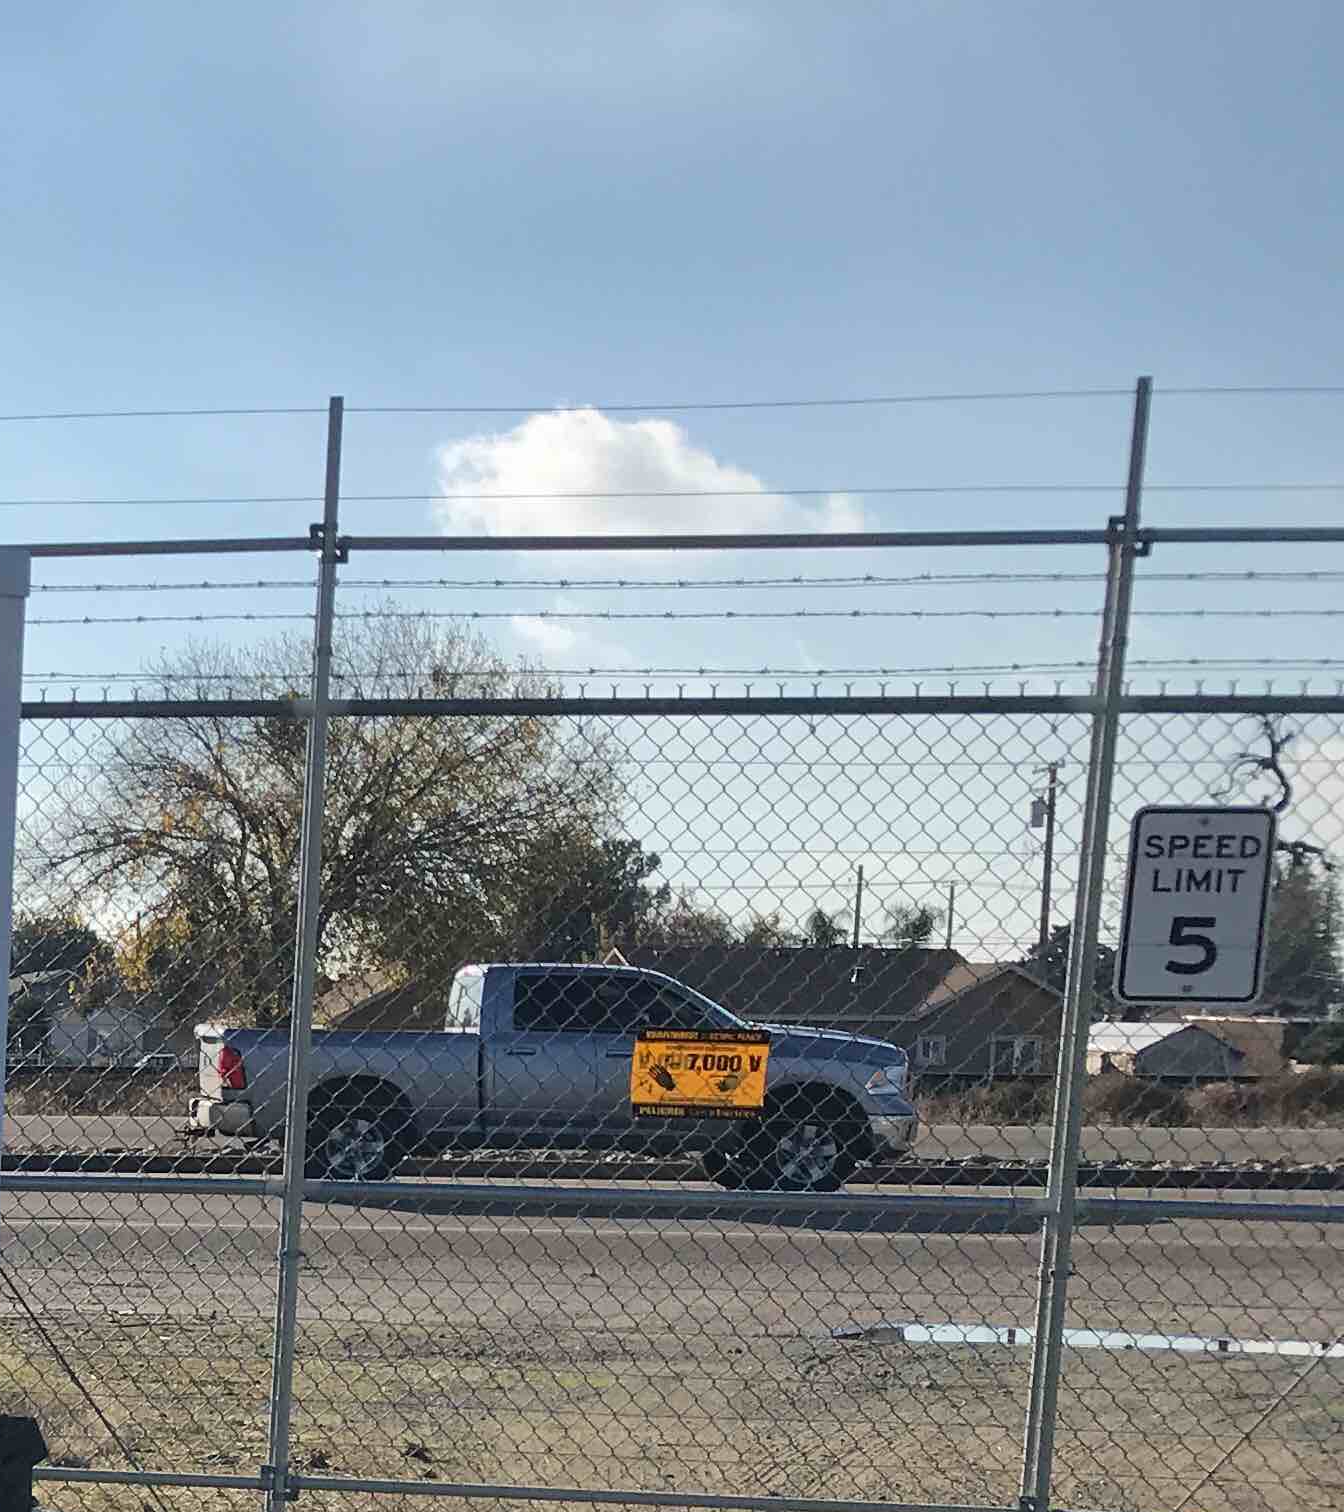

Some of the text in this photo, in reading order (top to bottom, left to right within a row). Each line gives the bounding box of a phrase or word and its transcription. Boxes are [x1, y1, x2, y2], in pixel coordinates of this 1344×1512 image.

[1144, 834, 1261, 859] SPEED
[1151, 868, 1247, 894] LIMIT
[1164, 916, 1218, 975] 5
